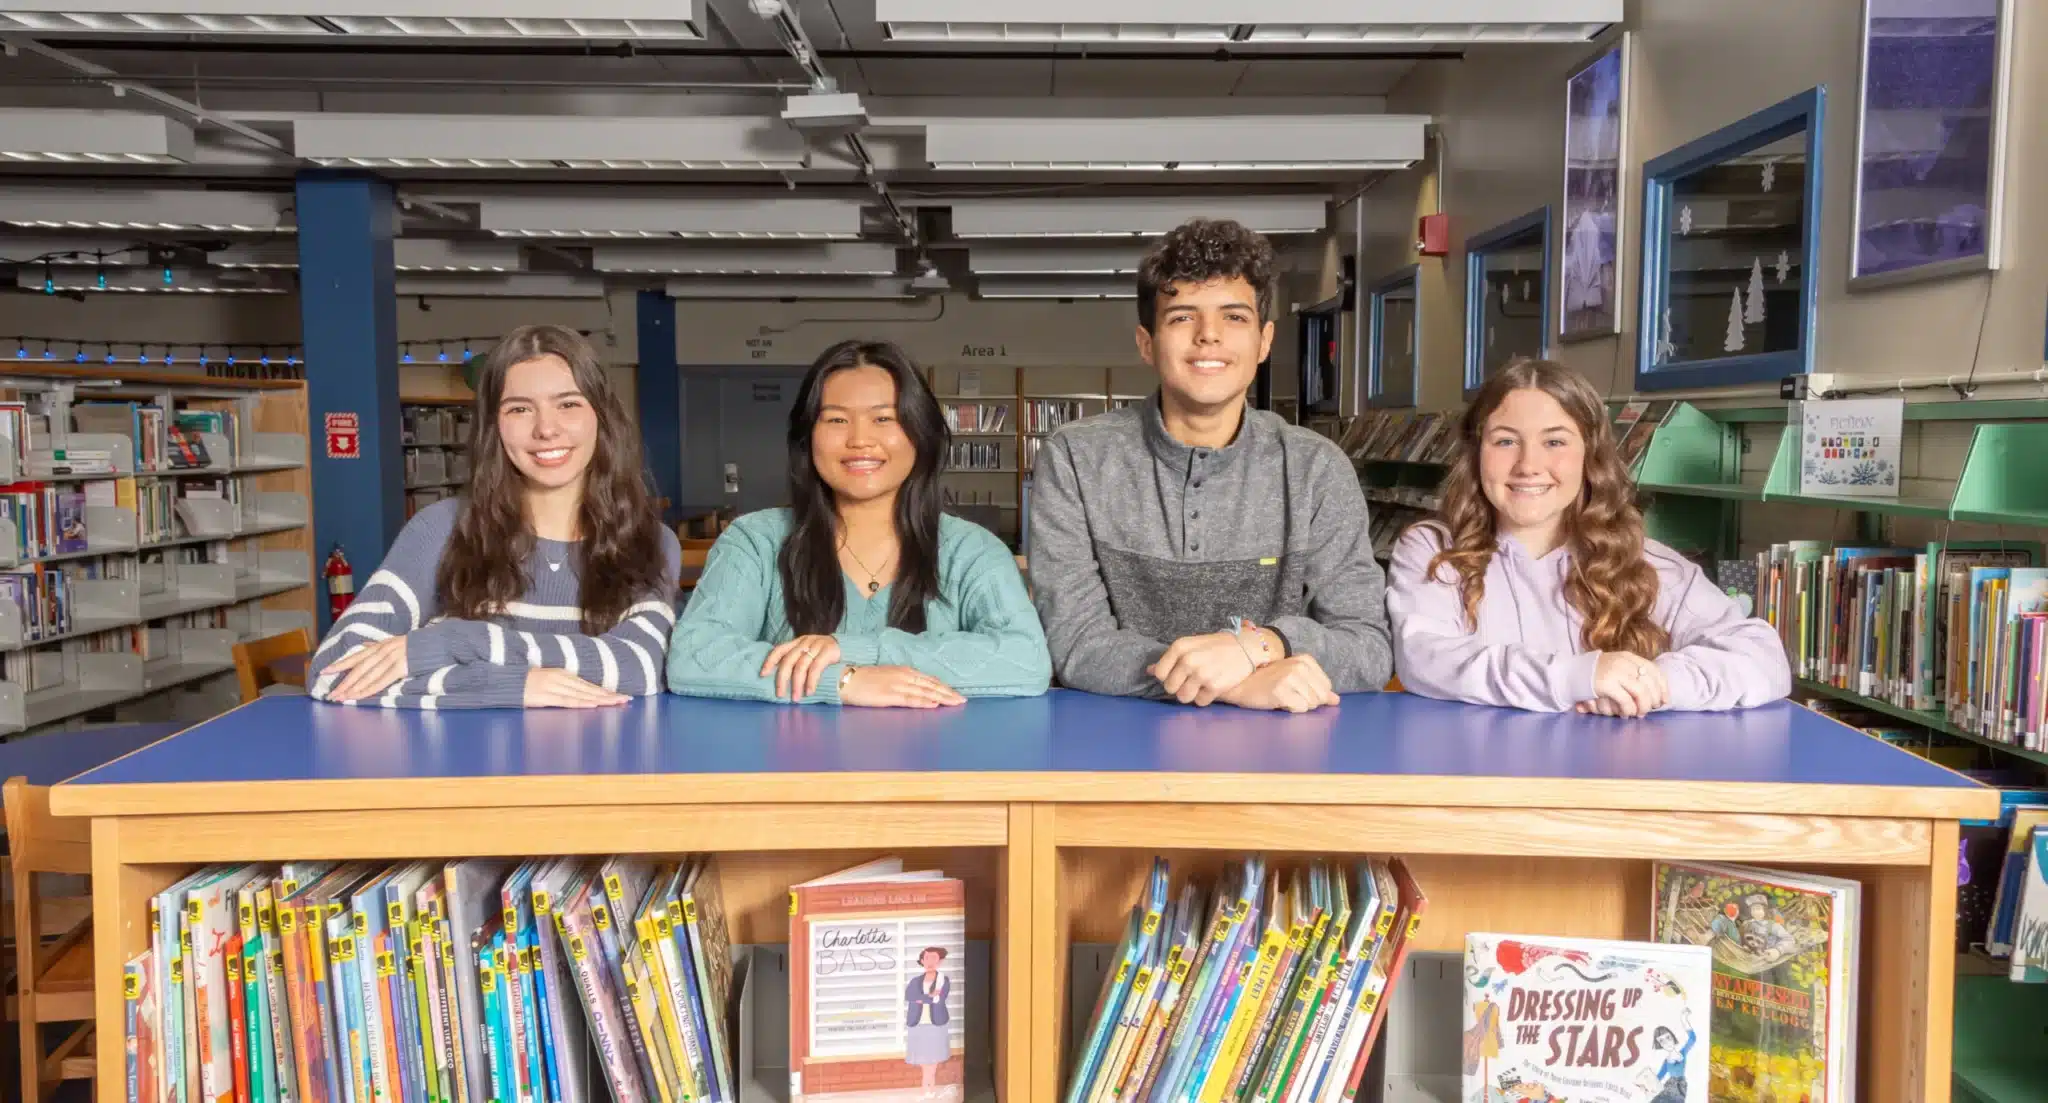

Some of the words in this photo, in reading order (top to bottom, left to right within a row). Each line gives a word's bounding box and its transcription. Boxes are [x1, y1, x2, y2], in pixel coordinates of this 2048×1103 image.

[961, 344, 995, 357] Area
[1000, 344, 1008, 357] 1
[822, 928, 892, 948] Charlotta
[265, 954, 274, 974] Just
[816, 947, 897, 976] BASS
[268, 987, 278, 1014] Lucky
[363, 981, 375, 1021] HENRY'S
[580, 970, 597, 1005] QUALLS
[1249, 977, 1266, 1000] PEET
[438, 988, 450, 1027] DIFFERENT
[1506, 986, 1616, 1021] DRESSING
[1621, 987, 1643, 1008] UP
[1739, 1001, 1812, 1030] KELLOGG
[444, 1029, 452, 1045] LIKE
[622, 1003, 644, 1054] DISSENT
[674, 989, 692, 1028] SPORTING
[685, 1030, 699, 1059] CHANCE
[1283, 1010, 1300, 1038] ELVIS
[446, 1047, 454, 1069] COCO
[1240, 1032, 1268, 1086] BONES
[1516, 1025, 1541, 1045] THE
[1545, 1024, 1644, 1068] STARS
